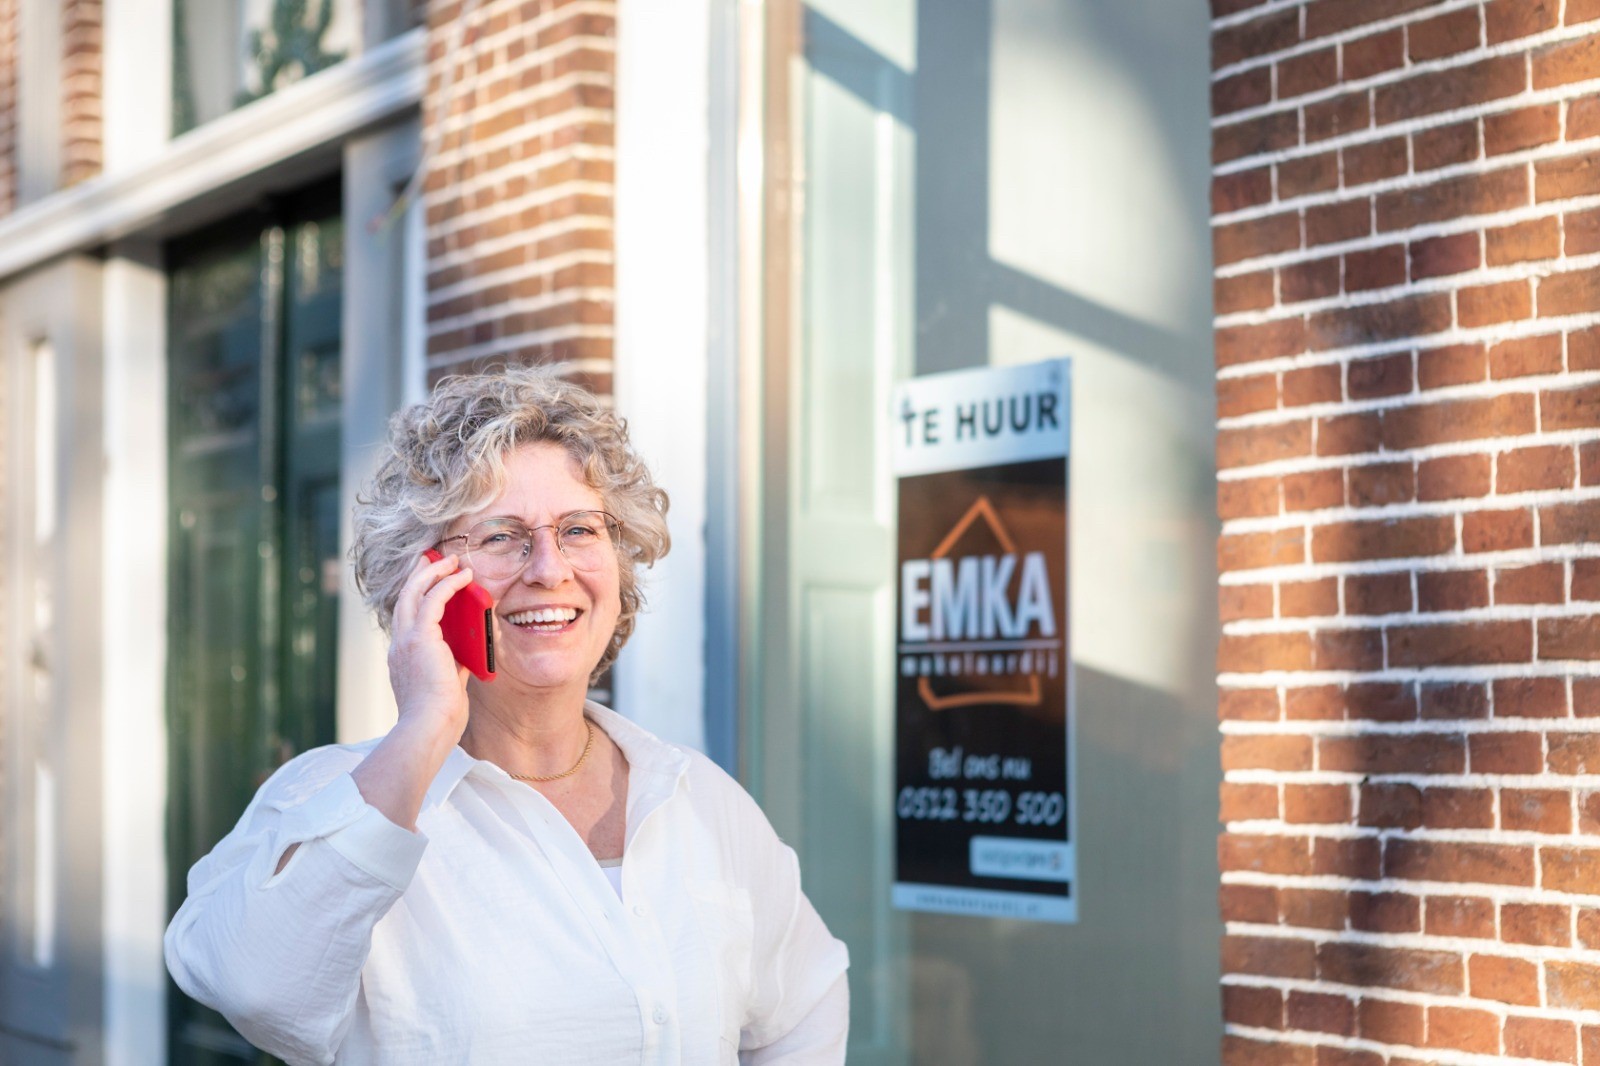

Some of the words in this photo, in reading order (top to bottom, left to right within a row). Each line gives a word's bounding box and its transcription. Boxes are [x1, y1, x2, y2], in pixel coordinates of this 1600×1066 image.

[956, 391, 1059, 441] HUUR
[902, 552, 1057, 641] EMKA
[929, 746, 963, 780] Bel
[963, 754, 999, 780] ons
[1002, 758, 1031, 780] nu
[899, 786, 958, 820] 0512
[963, 789, 1011, 823] 350
[1015, 792, 1063, 826] 500
